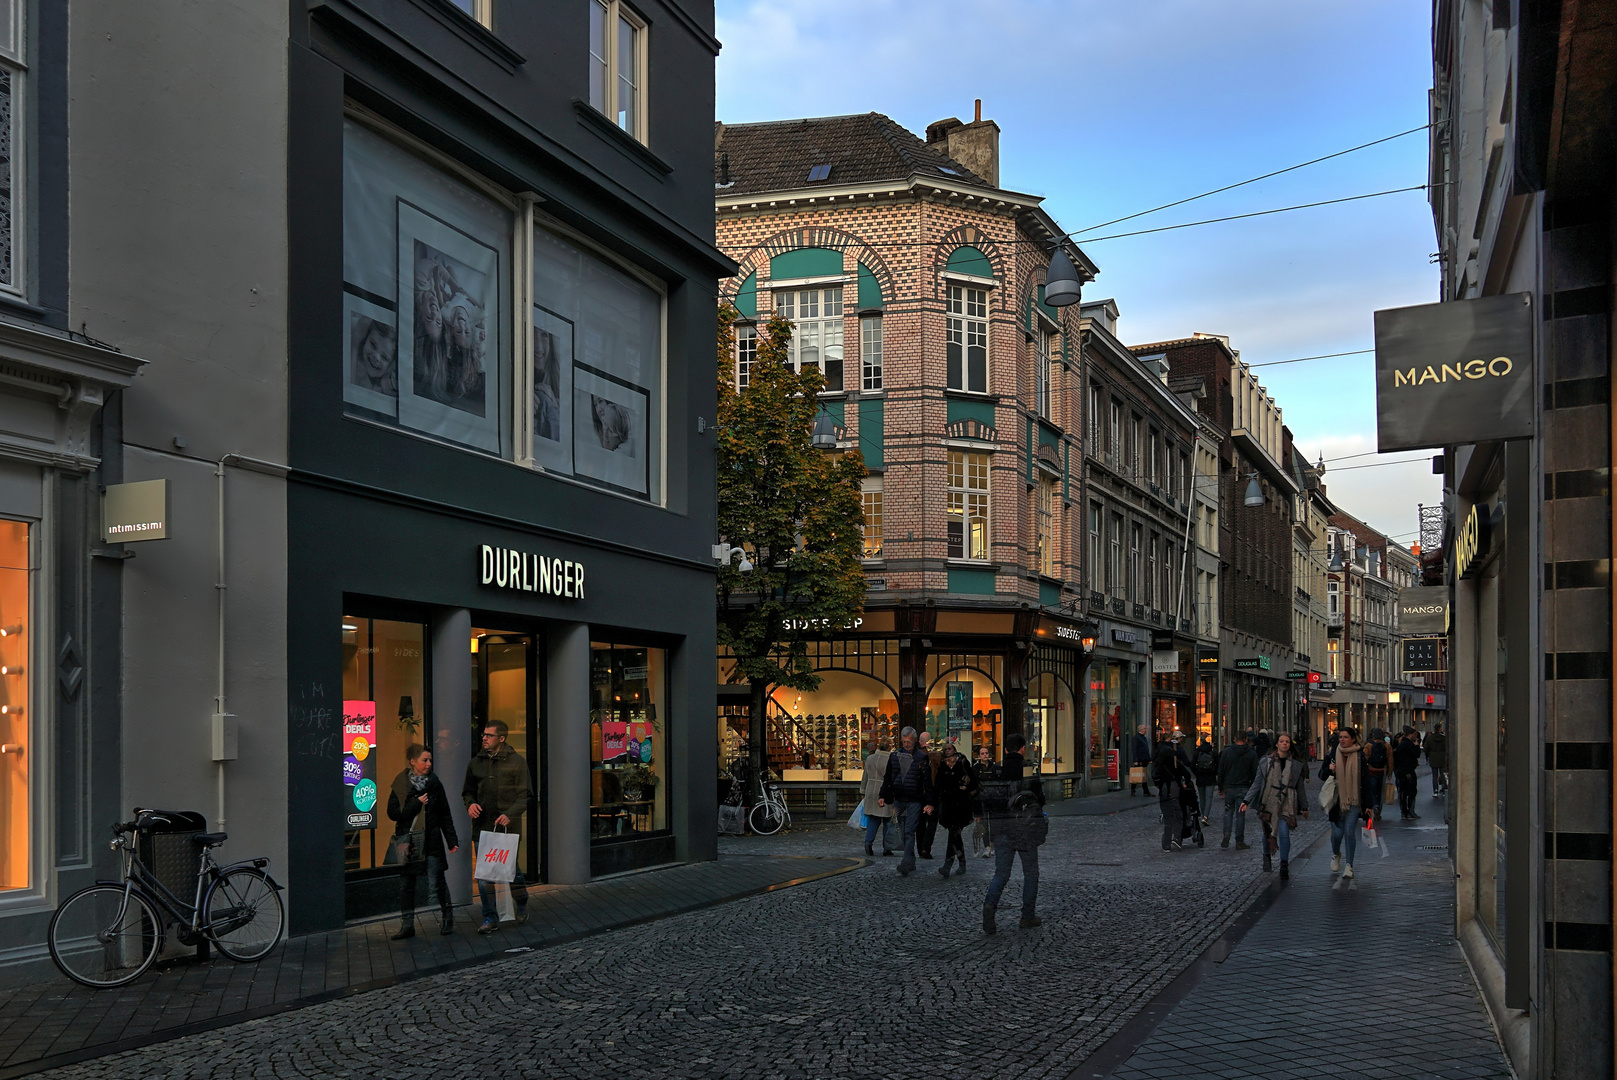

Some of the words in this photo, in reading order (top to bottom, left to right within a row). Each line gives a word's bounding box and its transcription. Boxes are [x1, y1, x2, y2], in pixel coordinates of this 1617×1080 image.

[1394, 356, 1513, 388] MANGO
[108, 521, 162, 534] intimissimi
[1455, 504, 1478, 580] MANGO
[481, 544, 585, 600] DURLINGER
[1403, 605, 1443, 614] MANGO
[782, 617, 863, 630] SIDESEP
[345, 724, 371, 734] DEALS
[353, 741, 368, 751] 20%
[606, 741, 623, 749] DEALS
[343, 761, 361, 774] 30%
[355, 784, 375, 798] 40%
[484, 848, 510, 865] H&M
